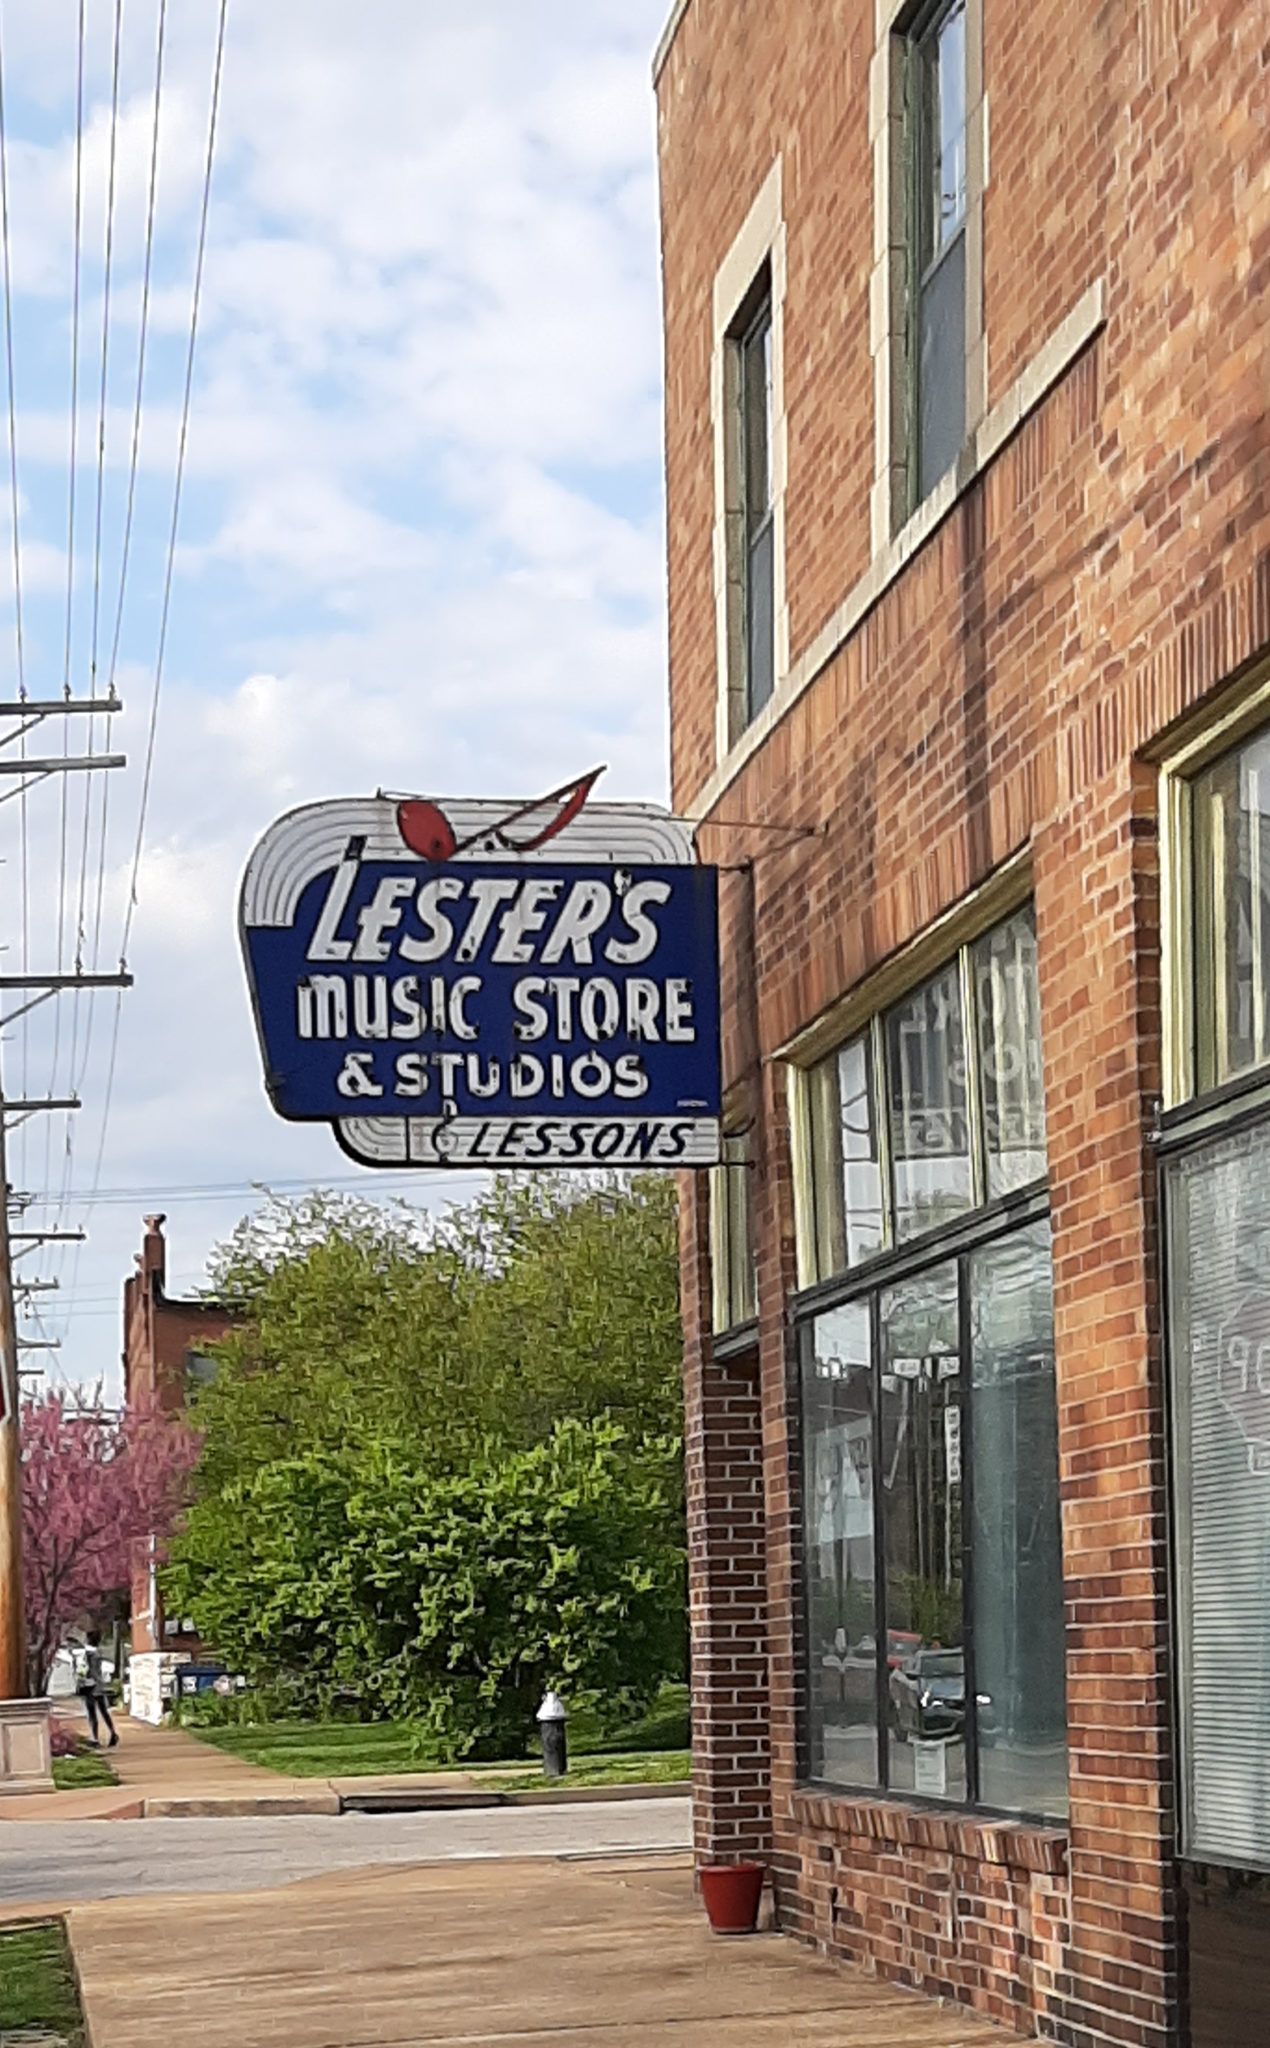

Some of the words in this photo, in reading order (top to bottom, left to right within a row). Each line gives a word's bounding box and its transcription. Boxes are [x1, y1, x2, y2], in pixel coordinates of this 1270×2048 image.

[306, 836, 671, 964] LESTER'S
[298, 974, 482, 1040] MUSIC
[513, 976, 696, 1042] STORE
[337, 1052, 383, 1098] &
[394, 1051, 649, 1098] STUDIOS
[467, 1121, 695, 1159] LESSONS
